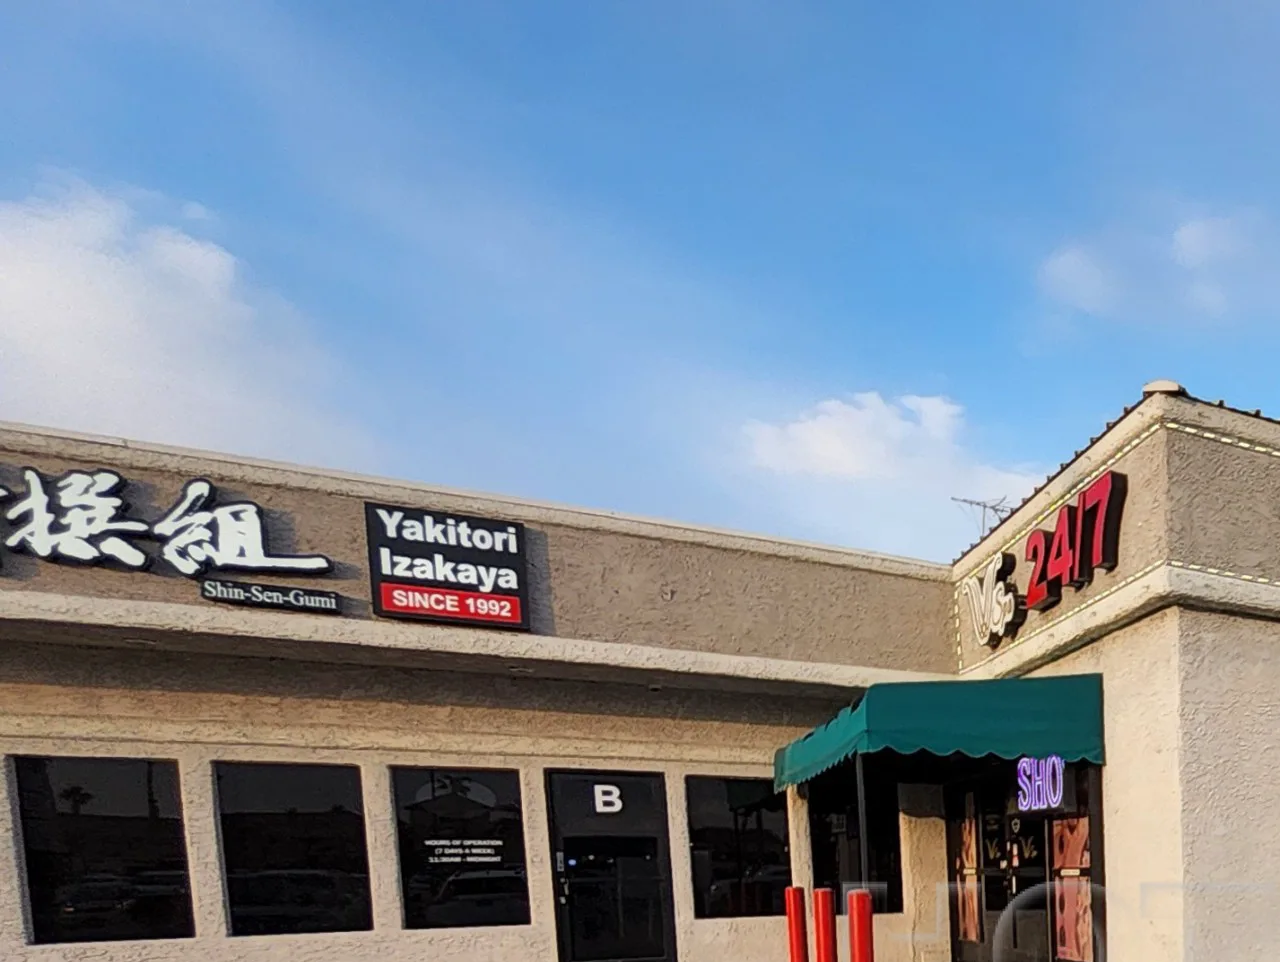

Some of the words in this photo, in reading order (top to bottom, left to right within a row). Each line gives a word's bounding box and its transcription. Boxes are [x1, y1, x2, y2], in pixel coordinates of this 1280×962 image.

[376, 508, 518, 554] Yakitori
[1026, 470, 1112, 610] 24/7
[378, 547, 519, 593] Izakaya
[204, 580, 337, 609] Shin-Sen-Gumi
[392, 590, 461, 612] SINCE
[465, 597, 512, 617] 1992
[594, 784, 623, 813] B
[1018, 755, 1065, 811] SHO
